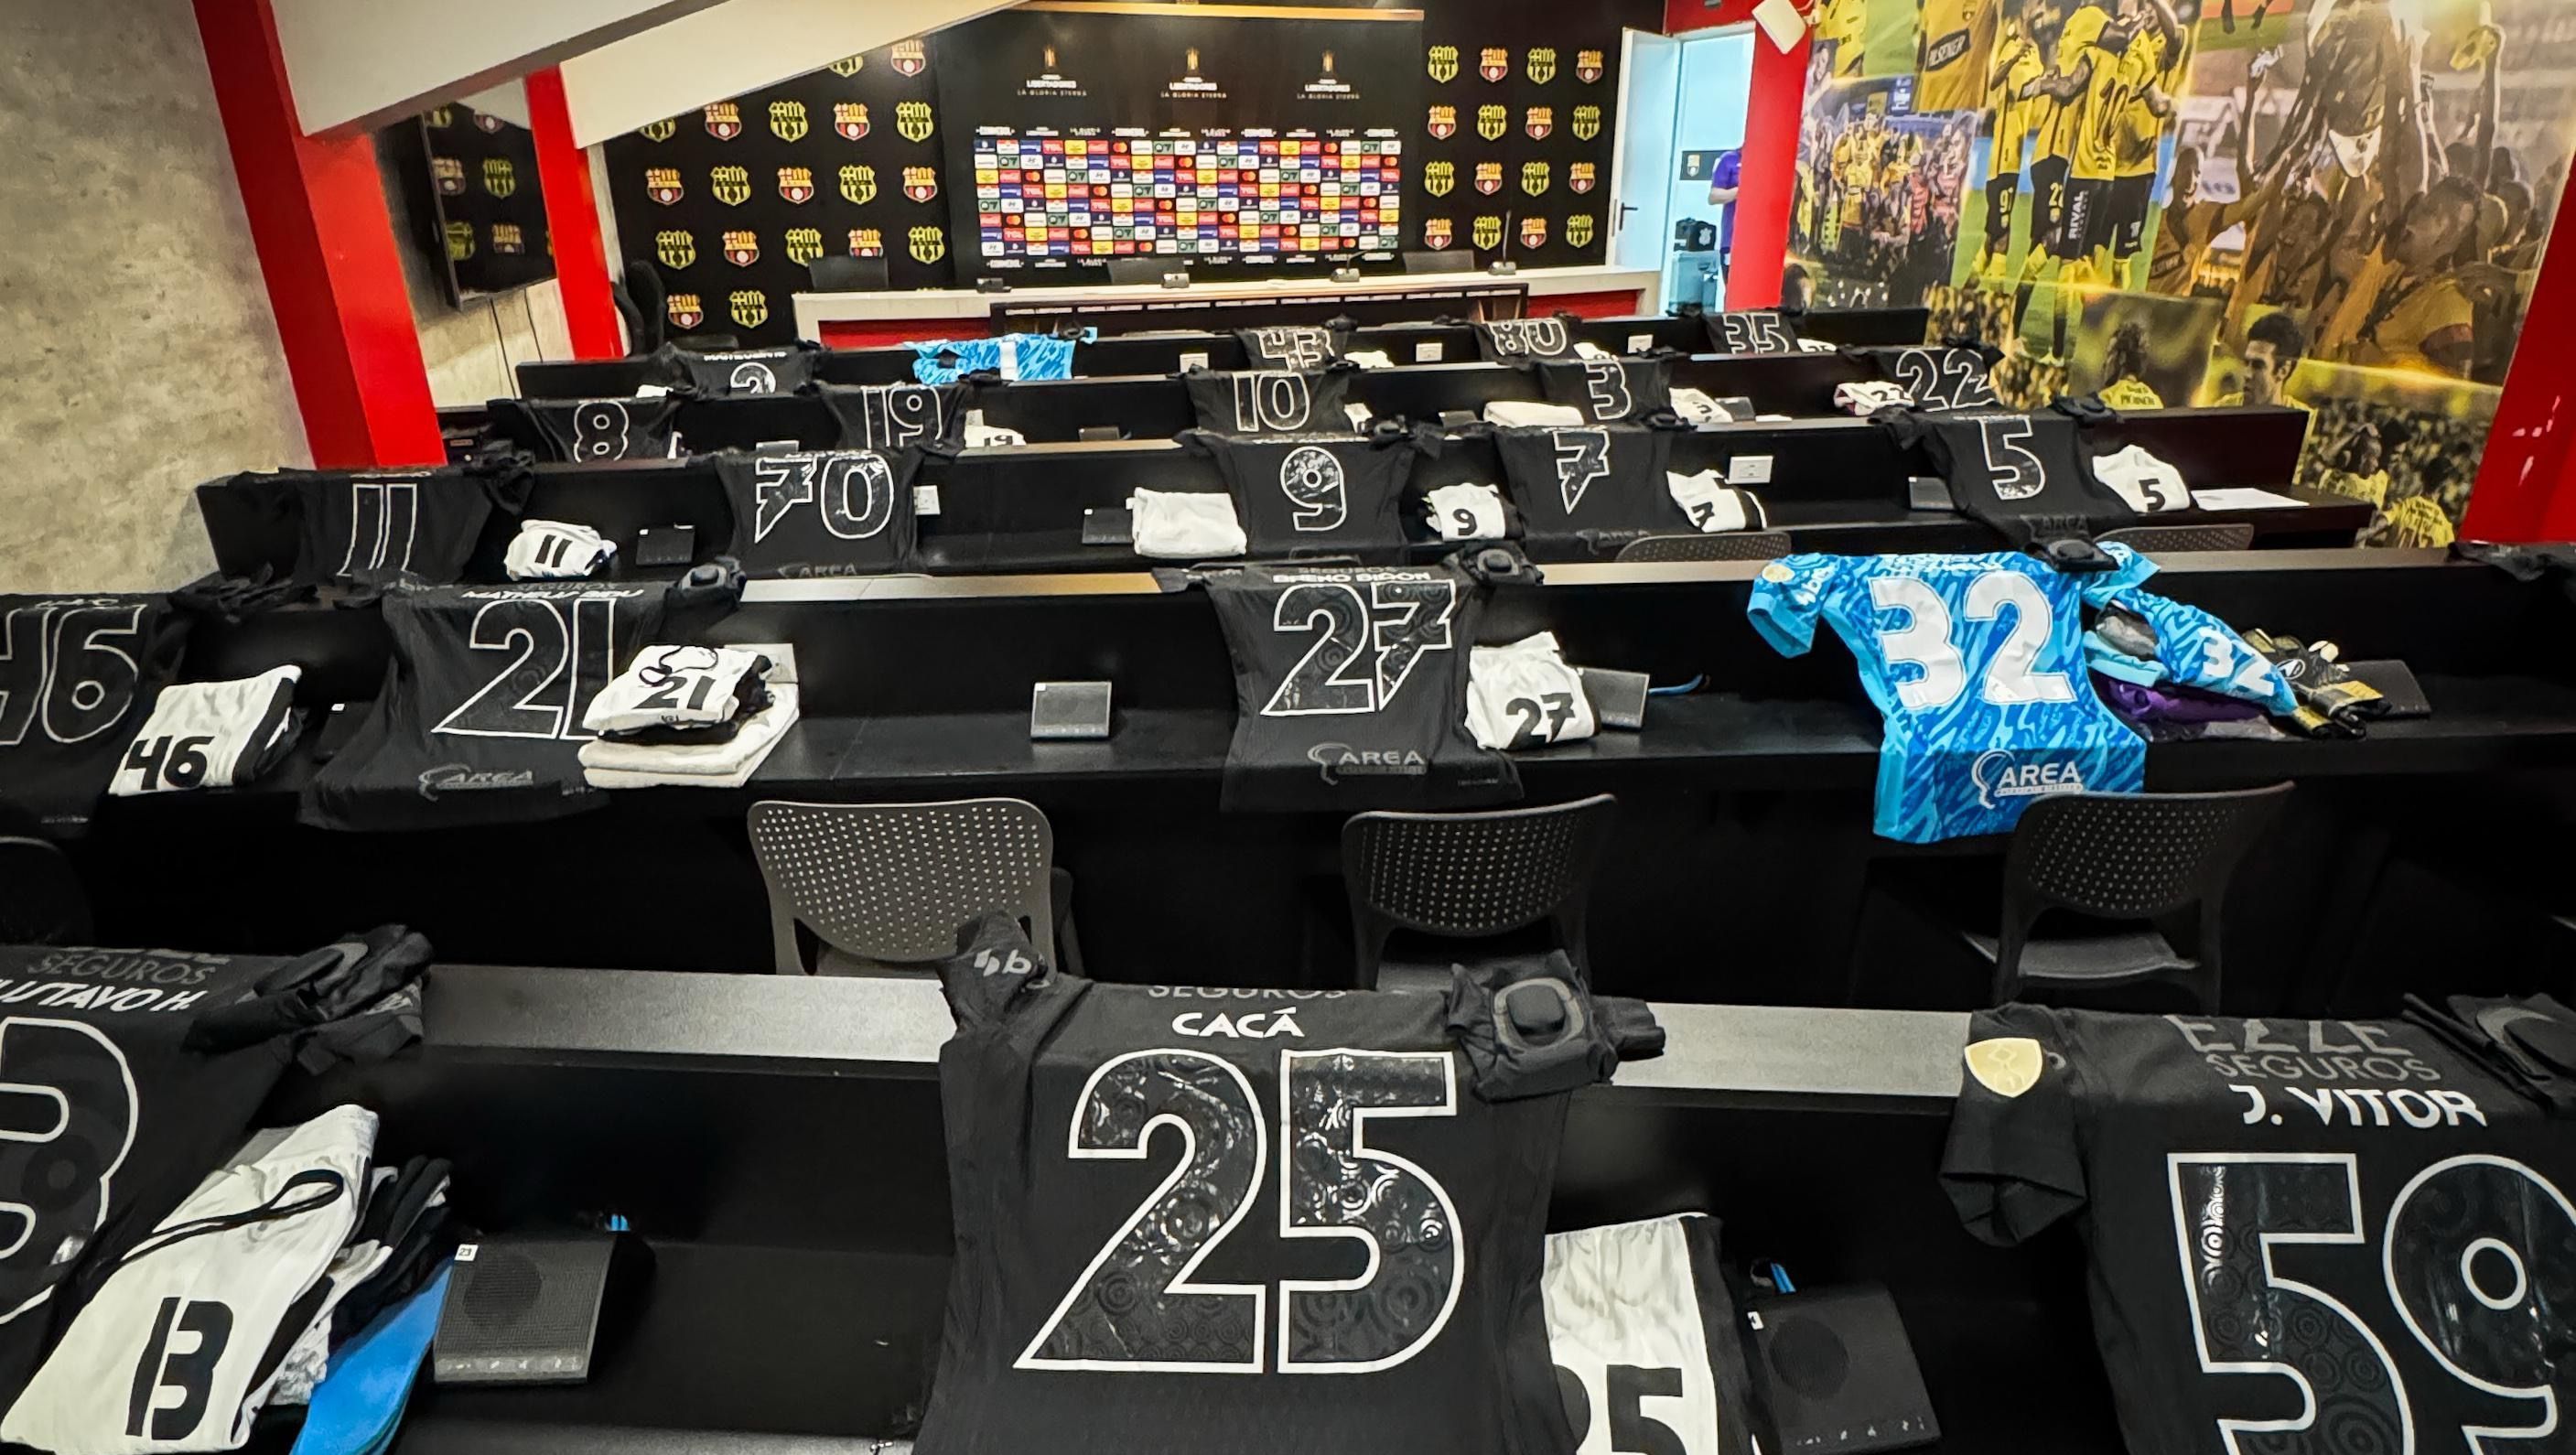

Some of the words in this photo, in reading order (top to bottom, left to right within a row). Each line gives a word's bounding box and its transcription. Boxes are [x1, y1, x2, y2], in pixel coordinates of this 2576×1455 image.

[1722, 312, 1790, 355] 35
[1233, 372, 1310, 432] 10
[1583, 359, 1632, 420] 3
[1896, 348, 1997, 412] 22
[574, 400, 629, 462] 8
[861, 384, 943, 449] 19
[1280, 446, 1347, 531] 9
[1553, 428, 1611, 514] 7
[1978, 415, 2046, 501] 5
[755, 454, 894, 544] 70
[1452, 508, 1478, 536] 9
[2138, 478, 2166, 511] 5
[336, 482, 419, 577] 11
[534, 534, 573, 568] 11
[430, 597, 617, 742] 21
[1259, 578, 1457, 717] 27
[1868, 571, 2079, 710] 32
[2197, 625, 2275, 697] 32
[631, 674, 717, 711] 21
[1505, 692, 1576, 749] 27
[124, 735, 216, 791] 46
[1338, 749, 1426, 765] AREA
[1997, 760, 2083, 788] AREA
[0, 978, 165, 1012] USTAVO
[27, 952, 216, 986] SEGUROS
[1171, 1007, 1306, 1039] CACÁ
[2204, 1053, 2441, 1082] SEGUROS
[2227, 1083, 2283, 1126] J.
[2284, 1085, 2488, 1129] VITOR
[1012, 1047, 1465, 1376] 25
[2167, 1152, 2576, 1455] 59
[125, 1296, 234, 1441] 13
